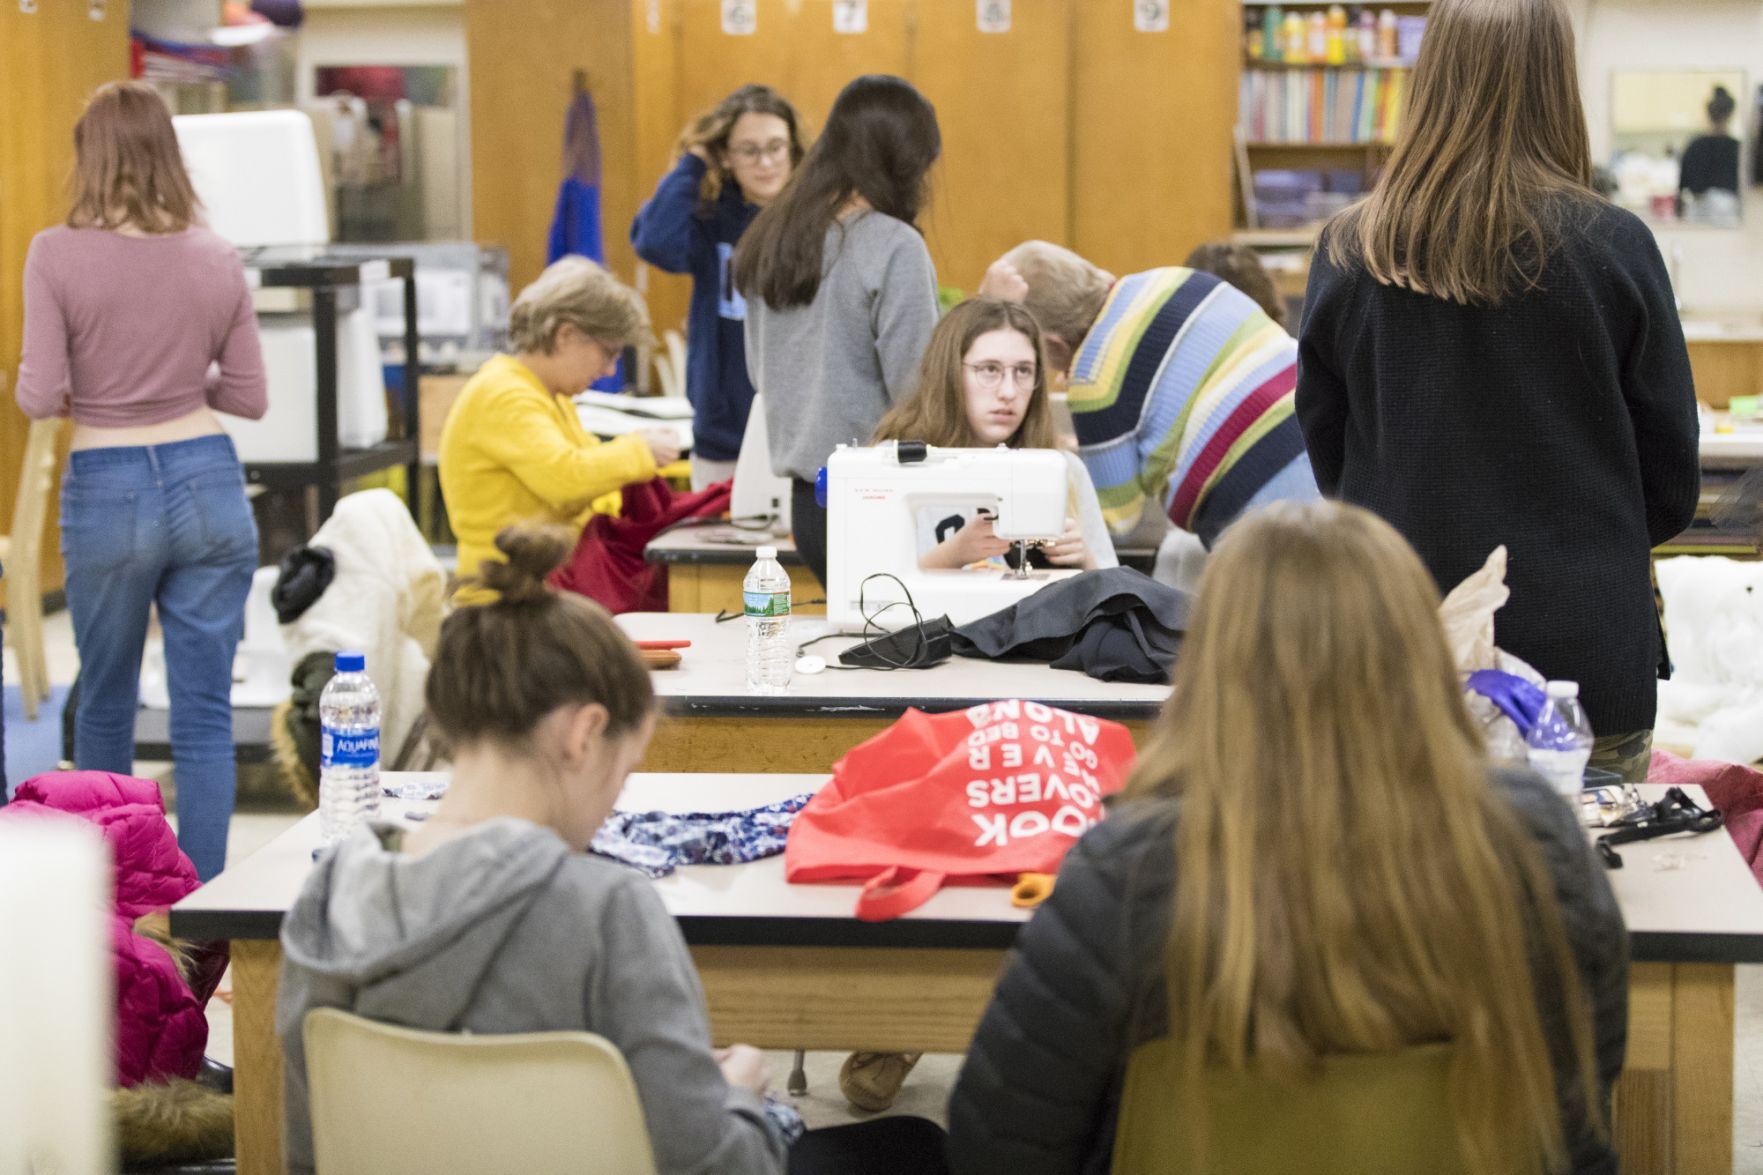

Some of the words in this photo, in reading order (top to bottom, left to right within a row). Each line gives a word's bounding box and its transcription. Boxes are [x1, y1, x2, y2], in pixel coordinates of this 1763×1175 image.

[965, 699, 1100, 745] ALONE
[967, 722, 1020, 747] BED
[337, 736, 379, 752] AQUAFIN
[1030, 724, 1065, 747] TO
[1069, 741, 1098, 769] GO
[971, 805, 1098, 847] OOK
